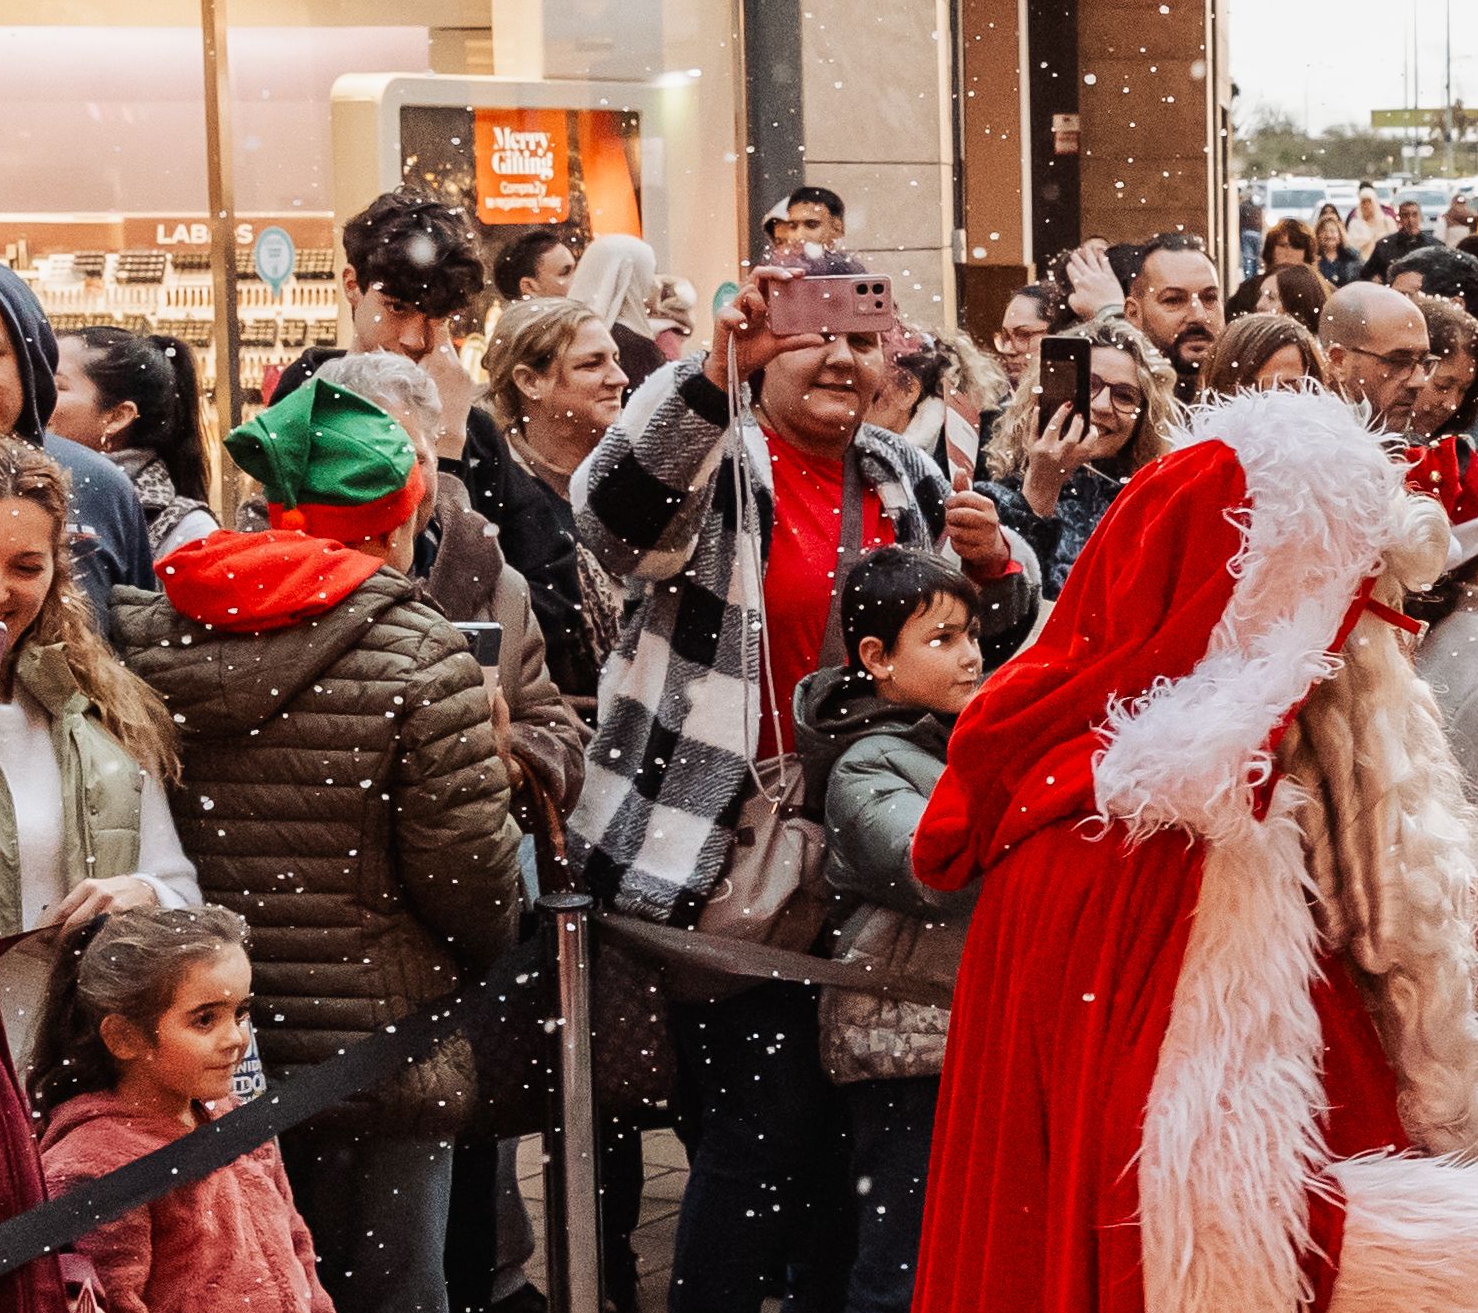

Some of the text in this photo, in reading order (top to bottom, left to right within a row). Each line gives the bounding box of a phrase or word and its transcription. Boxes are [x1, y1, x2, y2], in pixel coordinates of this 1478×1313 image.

[492, 126, 550, 157] Merry
[490, 149, 554, 181] Gifting
[156, 223, 254, 245] LABS
